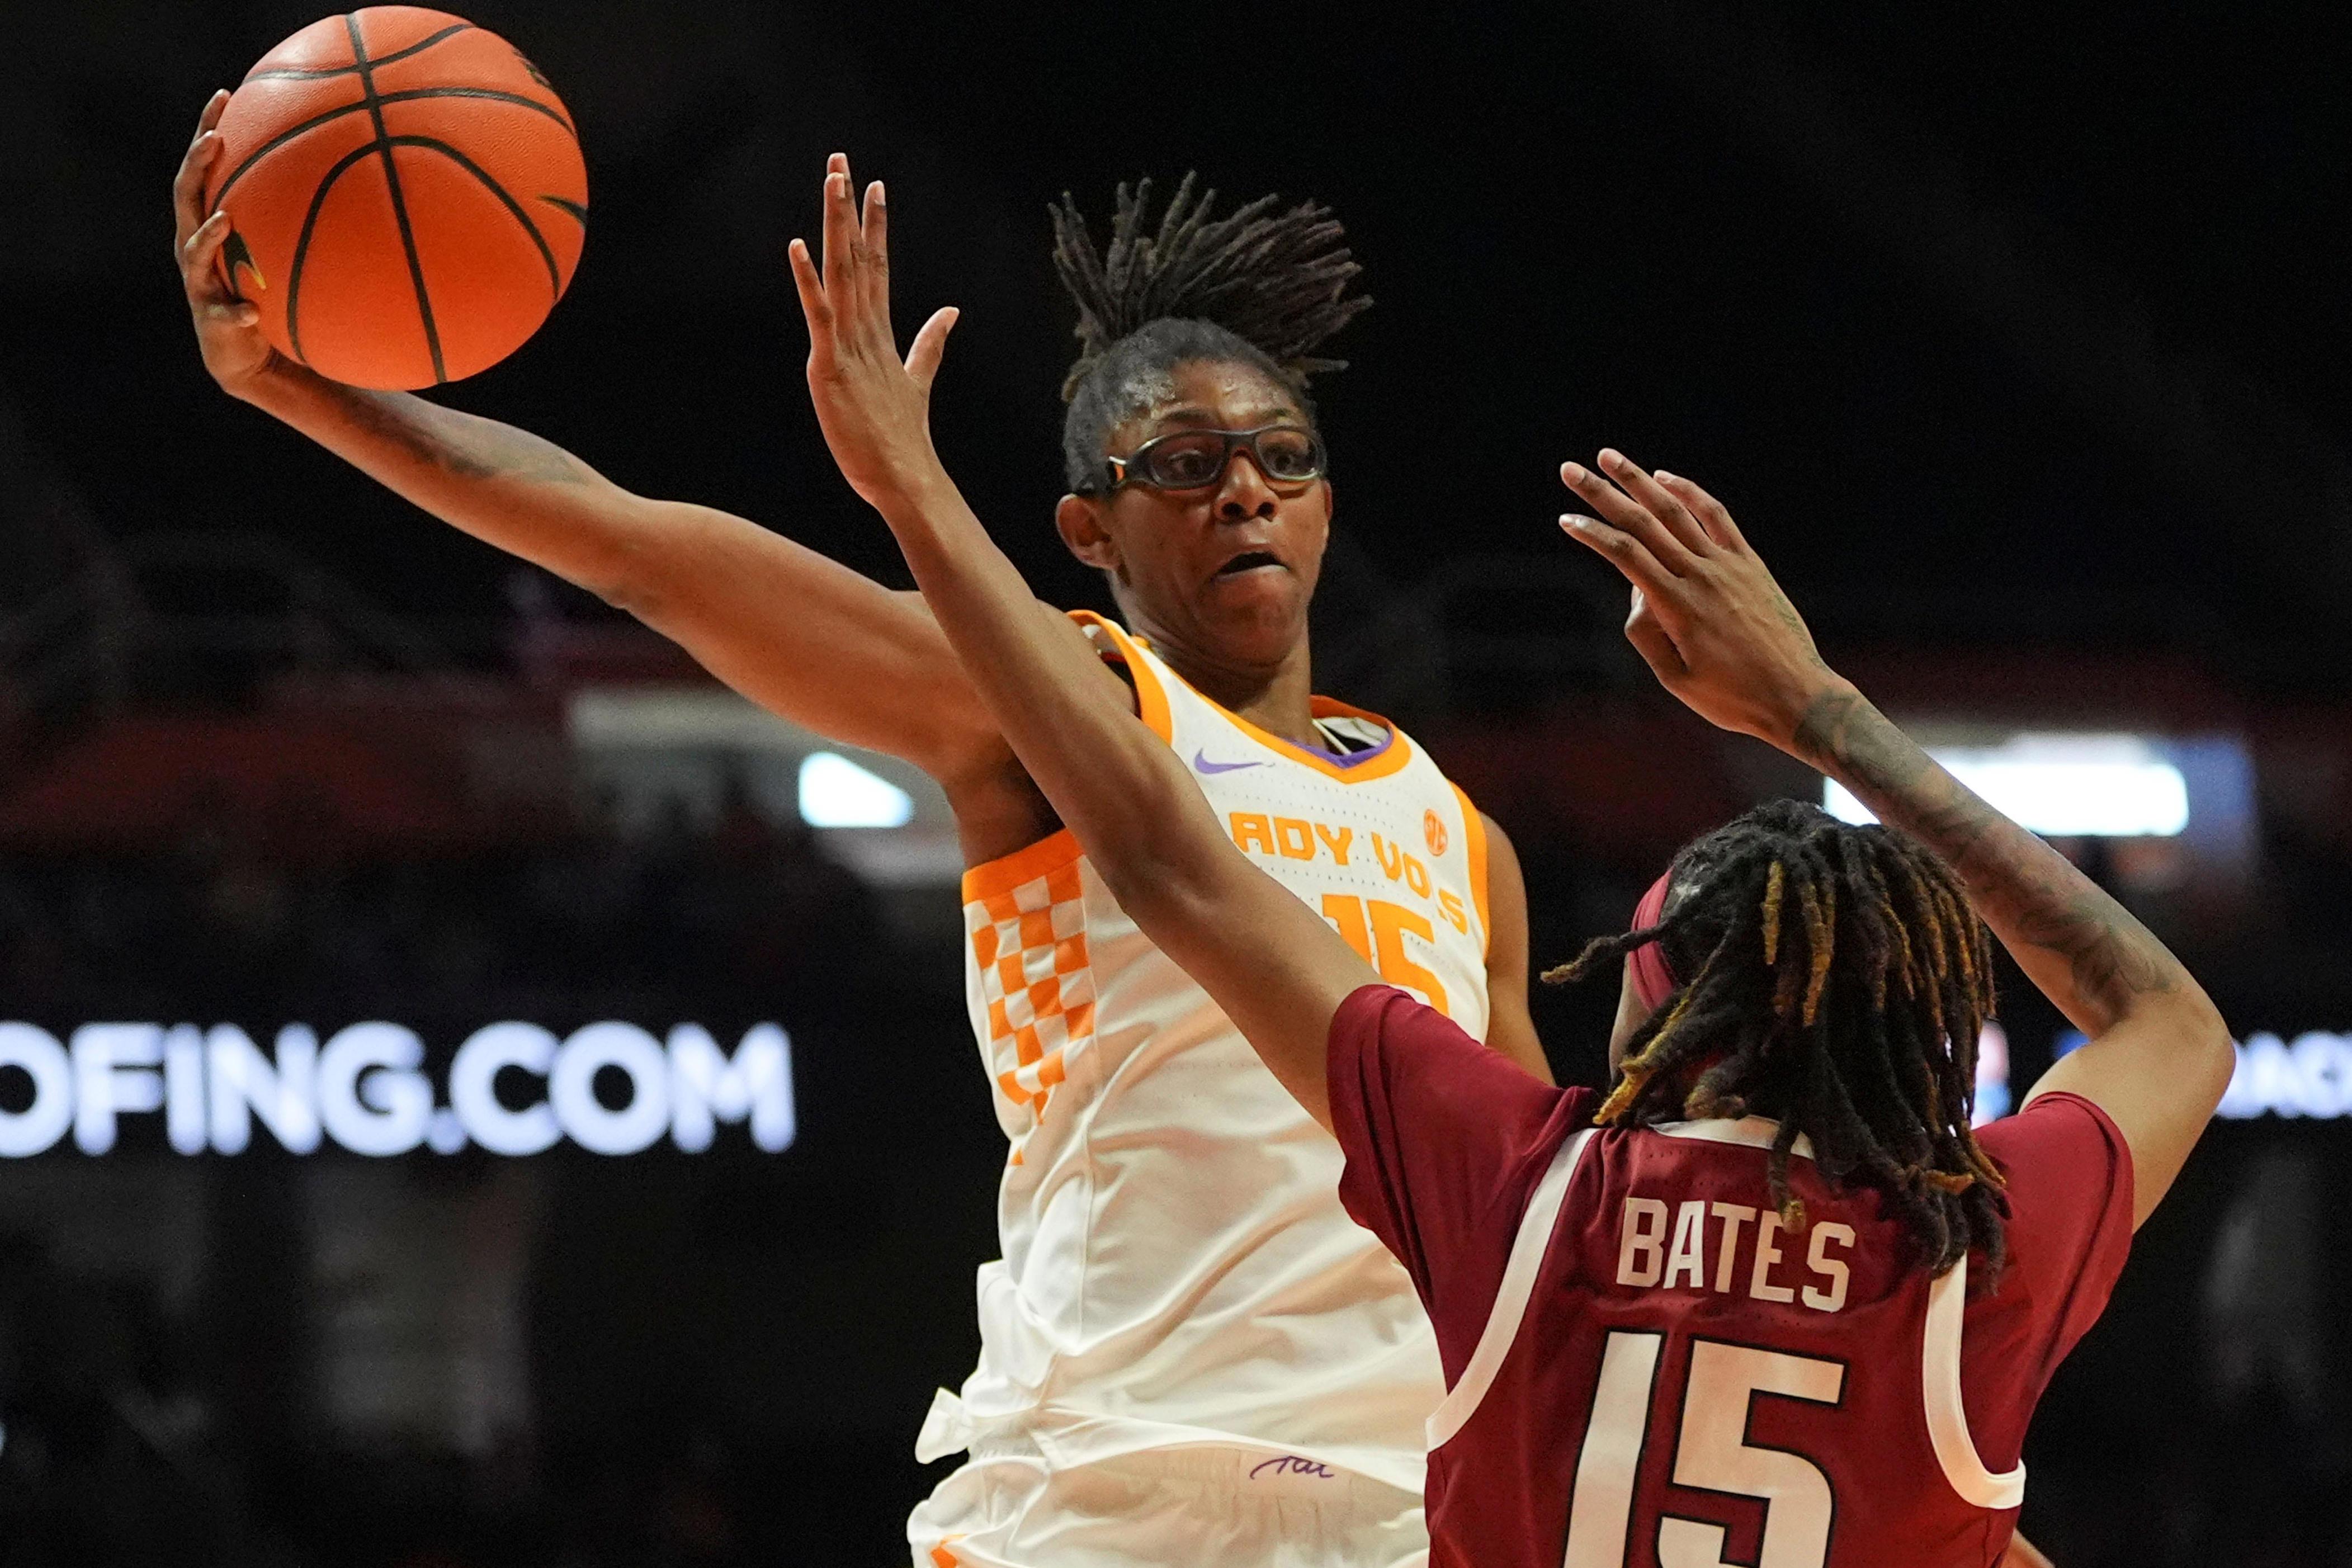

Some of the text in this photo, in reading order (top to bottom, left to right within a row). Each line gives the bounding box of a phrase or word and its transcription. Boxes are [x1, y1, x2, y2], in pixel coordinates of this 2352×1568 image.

[1229, 812, 1353, 866] ADY
[1616, 1197, 1857, 1314] BATES
[1561, 1329, 1849, 1568] 15
